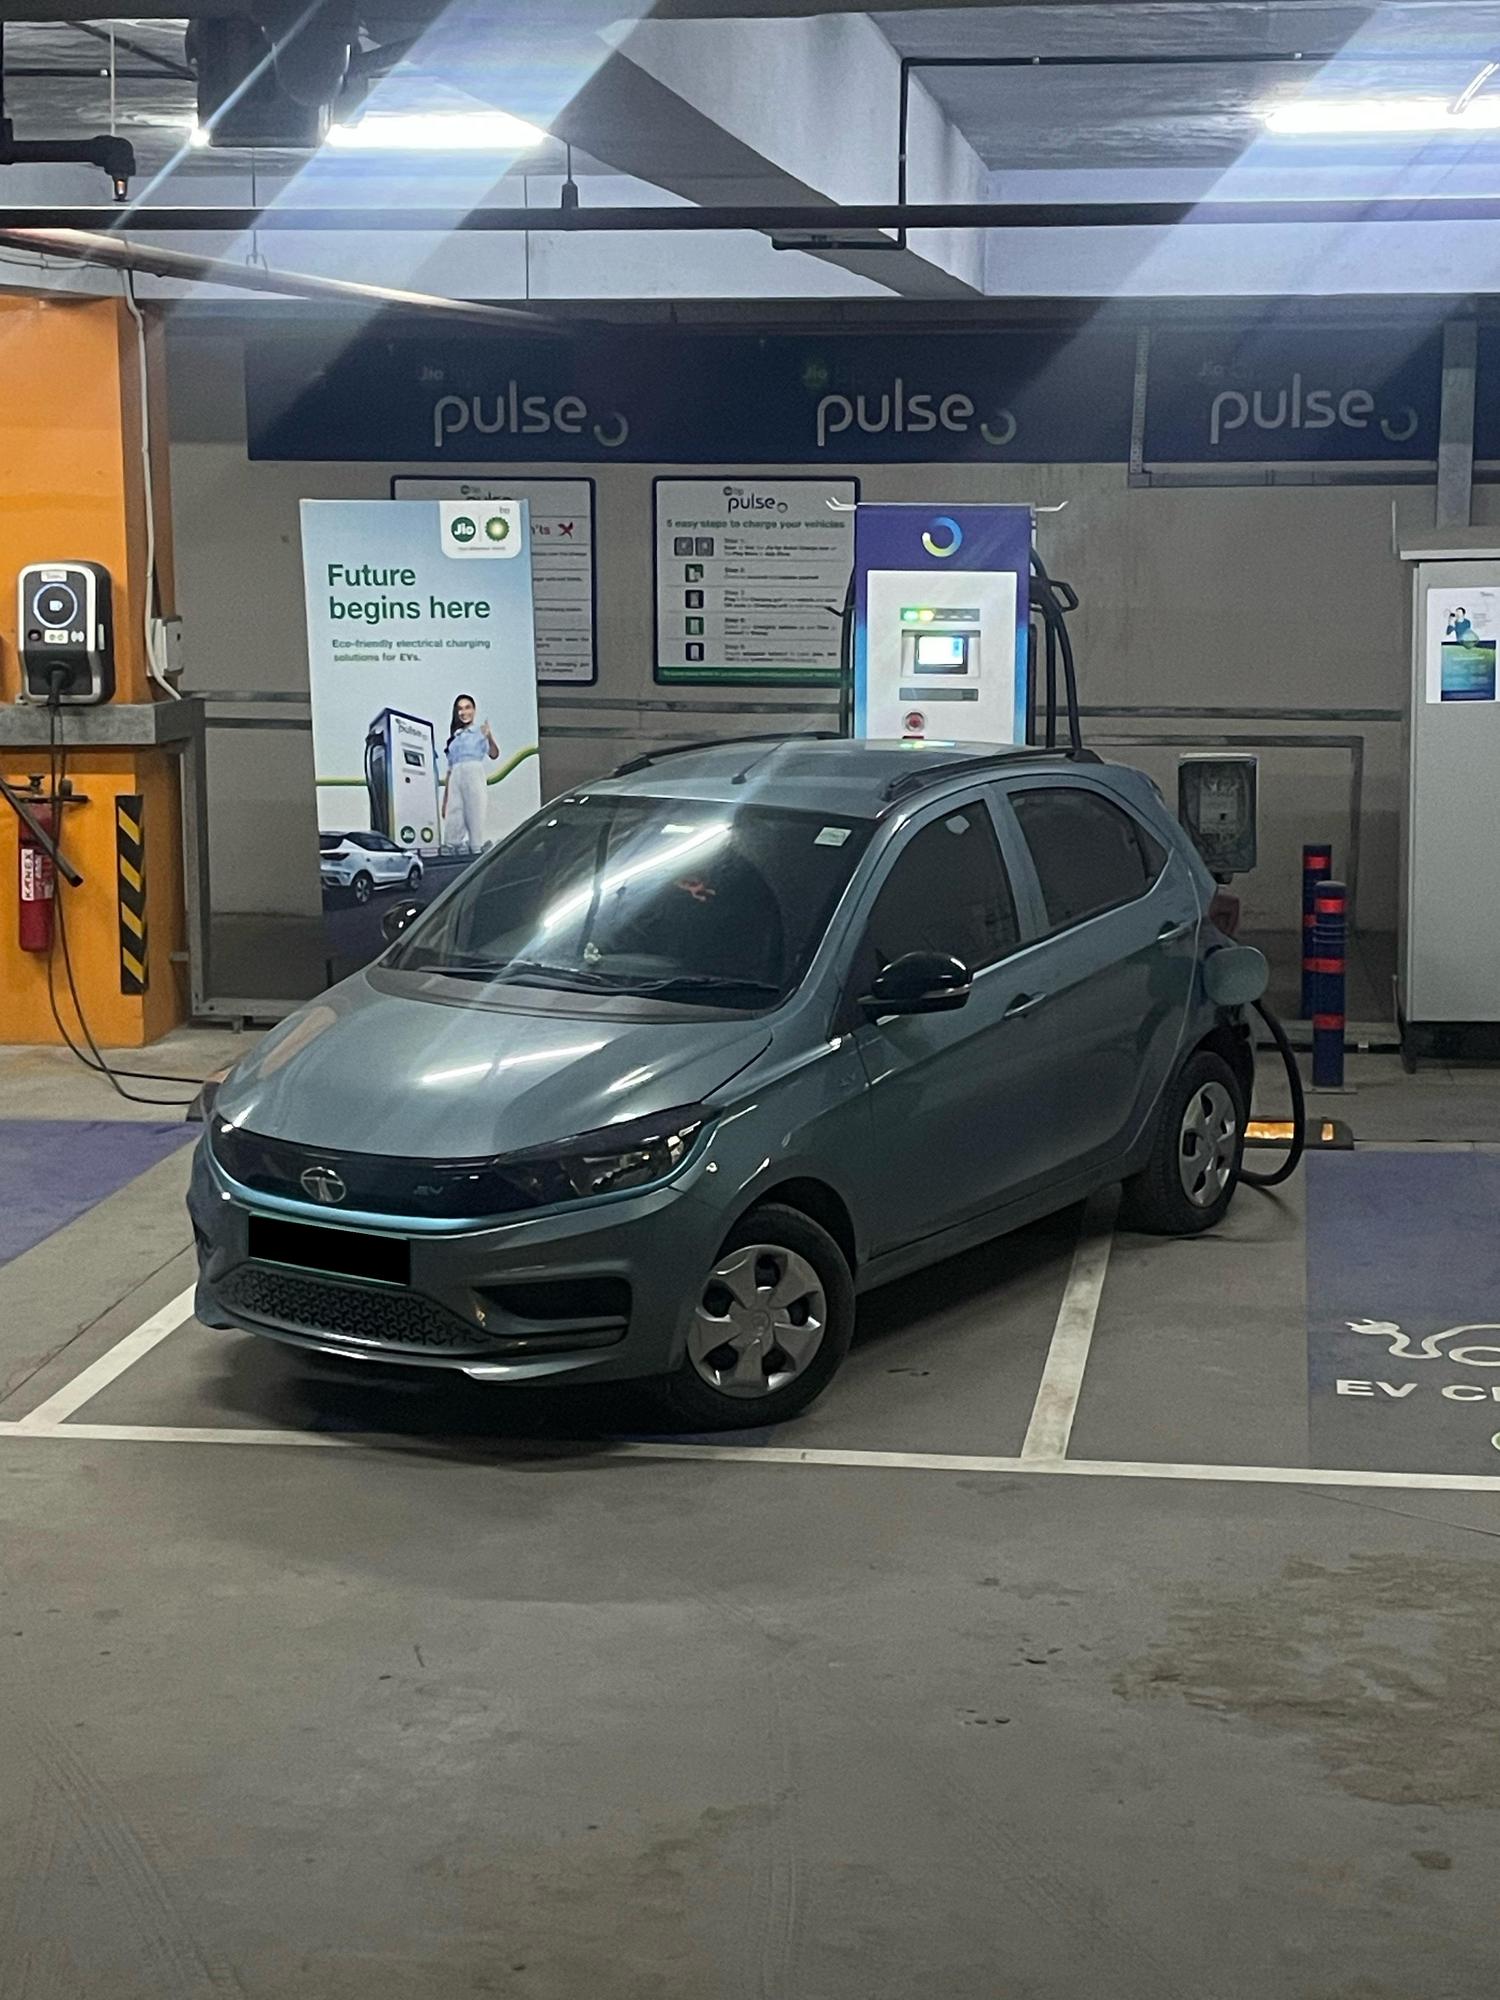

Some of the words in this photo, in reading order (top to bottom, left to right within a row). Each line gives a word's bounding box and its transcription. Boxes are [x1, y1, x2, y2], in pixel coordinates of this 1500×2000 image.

[434, 380, 587, 447] pulse
[817, 378, 974, 446] pulse
[1210, 373, 1374, 444] pulse
[728, 494, 775, 514] pulse
[454, 522, 475, 536] Jio
[675, 521, 698, 530] easy
[701, 519, 727, 530] steps
[730, 519, 741, 528] to
[743, 519, 777, 530] charge
[779, 520, 801, 530] your
[805, 519, 845, 529] vehicles
[328, 564, 416, 586] Future
[330, 595, 420, 624] begins
[430, 596, 490, 618] here
[332, 639, 393, 649] Eco-friendly
[396, 639, 443, 648] electrical
[446, 639, 491, 649] charging
[334, 653, 379, 662] solutions
[382, 653, 396, 662] for
[1336, 1379, 1418, 1397] EV
